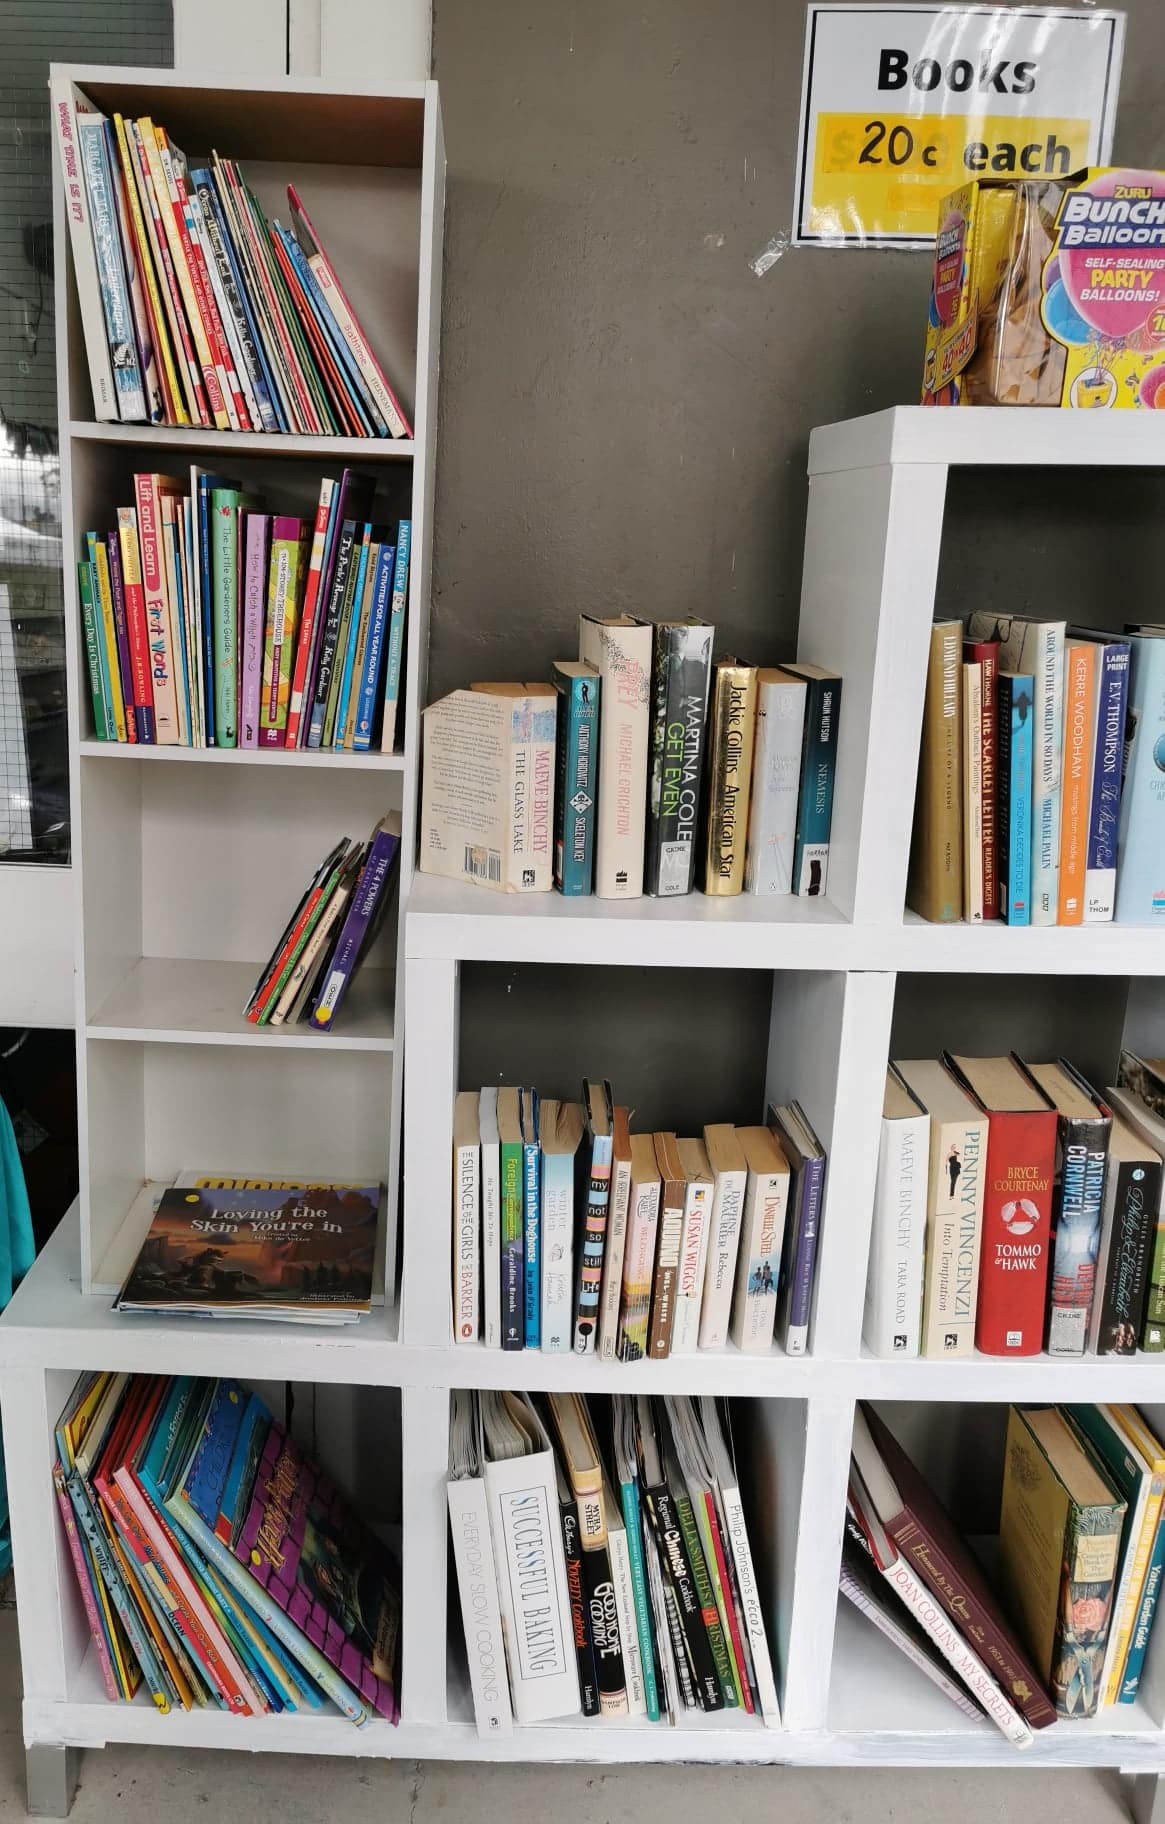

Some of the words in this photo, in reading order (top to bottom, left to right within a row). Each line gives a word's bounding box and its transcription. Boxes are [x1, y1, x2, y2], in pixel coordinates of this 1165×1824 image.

[878, 49, 1037, 94] Books
[59, 102, 73, 142] WHAT
[64, 145, 77, 177] TIME
[963, 135, 1071, 173] each
[70, 184, 82, 197] IS
[1114, 185, 1152, 199] ZURU
[1080, 289, 1160, 301] BALLOONS!
[1091, 269, 1153, 288] PARTY
[344, 325, 368, 365] Bathtime
[206, 376, 221, 410] Collins
[140, 481, 151, 503] Lift
[143, 506, 154, 532] and
[145, 538, 156, 575] Learn
[399, 525, 409, 558] NANCY
[378, 564, 389, 603] ACTIVITIES
[397, 560, 407, 588] DREW
[84, 603, 95, 624] Every
[149, 599, 164, 635] First
[374, 620, 382, 634] ALL
[376, 604, 384, 619] FOR
[87, 628, 98, 642] Day
[1045, 629, 1056, 671] AROUND
[152, 640, 168, 686] Words
[321, 647, 333, 665] Kelly
[367, 656, 377, 684] ROUND
[1107, 663, 1127, 671] PRINT
[90, 654, 101, 694] Christmas
[317, 667, 329, 697] Gardiner
[984, 659, 993, 707] HAWTHORNE
[1045, 673, 1055, 693] THE
[1075, 658, 1085, 697] KERRE
[729, 682, 747, 725] Jackie
[822, 692, 832, 713] SHAUN
[1108, 682, 1120, 702] E.V.
[820, 715, 831, 742] HUTSON
[983, 712, 993, 734] THE
[1044, 695, 1054, 730] WORLD
[578, 724, 590, 753] ANTHONY
[618, 723, 633, 774] MICHAEL
[668, 722, 684, 763] GET
[682, 696, 702, 785] MARTINA
[726, 730, 743, 774] Collins
[1044, 733, 1053, 742] IN
[1044, 745, 1053, 757] 80
[1071, 701, 1085, 778] WOODHAM
[1103, 705, 1118, 773] THOMPSON
[515, 750, 526, 777] THE
[534, 749, 549, 796] MAEVE
[576, 756, 588, 787] HOROWITZ
[983, 739, 993, 793] SCARLET
[1043, 760, 1054, 783] DAYS
[514, 782, 525, 819] GLASS
[663, 768, 681, 816] EVEN
[816, 764, 828, 814] NEMESIS
[617, 779, 630, 835] CRICHTON
[677, 789, 694, 840] COLE
[721, 785, 740, 848] American
[983, 799, 993, 844] LETTER
[1042, 799, 1051, 842] MICHAEL
[513, 825, 524, 854] LAKE
[533, 800, 549, 853] BINCHY
[574, 817, 586, 848] SKELETON
[375, 858, 388, 874] THE
[573, 849, 585, 862] KEY
[719, 854, 735, 879] Star
[1042, 843, 1051, 869] PALIN
[361, 883, 379, 916] POWERS
[985, 881, 993, 904] DIGEST
[526, 1150, 537, 1190] Survival
[810, 1165, 821, 1181] THE
[900, 1132, 915, 1182] MAEVE
[960, 1130, 981, 1206] PENNY
[1008, 1167, 1039, 1179] BRYCE
[462, 1160, 473, 1210] SILENCE
[528, 1192, 536, 1200] in
[591, 1181, 607, 1191] my
[995, 1179, 1049, 1192] COURTENAY
[1062, 1146, 1086, 1217] CORNWELL
[1084, 1152, 1105, 1213] PATRICIA
[210, 1208, 282, 1220] Loving
[292, 1206, 328, 1218] the
[527, 1203, 536, 1218] the
[727, 1191, 740, 1236] DAPHNE
[807, 1186, 820, 1220] LETTERS
[897, 1190, 913, 1248] BINCHY
[190, 1219, 239, 1233] Skin
[250, 1221, 313, 1232] You're
[323, 1221, 343, 1233] in
[462, 1226, 473, 1259] GIRLS
[526, 1219, 537, 1263] Doghouse
[687, 1210, 702, 1248] SUSAN
[942, 1223, 955, 1246] Into
[509, 1248, 517, 1285] Geraldine
[954, 1211, 976, 1316] VINCENZI
[995, 1244, 1042, 1257] TOMMO
[1002, 1258, 1037, 1270] HAWK
[682, 1250, 697, 1290] WIGGS
[715, 1252, 729, 1289] Rebecca
[896, 1260, 908, 1288] TARA
[938, 1251, 952, 1311] Temptation
[462, 1272, 472, 1319] BARKER
[509, 1288, 517, 1312] Brooks
[896, 1292, 906, 1323] ROAD
[584, 1504, 596, 1536] STREET
[592, 1504, 603, 1531] MYRA
[657, 1496, 674, 1530] Regional
[728, 1505, 745, 1537] Philip
[461, 1512, 482, 1577] EVERYDAY
[510, 1496, 549, 1601] SUCCESSFUL
[664, 1531, 686, 1577] Chinese
[734, 1540, 753, 1594] Johnson's
[1145, 1565, 1162, 1597] Yates
[470, 1583, 489, 1625] SLOW
[679, 1578, 696, 1613] Cookbook
[889, 1566, 923, 1604] JOAN
[914, 1596, 962, 1653] COLLINS
[1138, 1597, 1154, 1626] Garden
[168, 1612, 186, 1636] OCEAN
[523, 1609, 558, 1671] BAKING
[1134, 1627, 1149, 1649] Guide
[475, 1630, 499, 1702] COOKING
[957, 1652, 982, 1680] MY
[974, 1675, 1016, 1726] SECRETS
